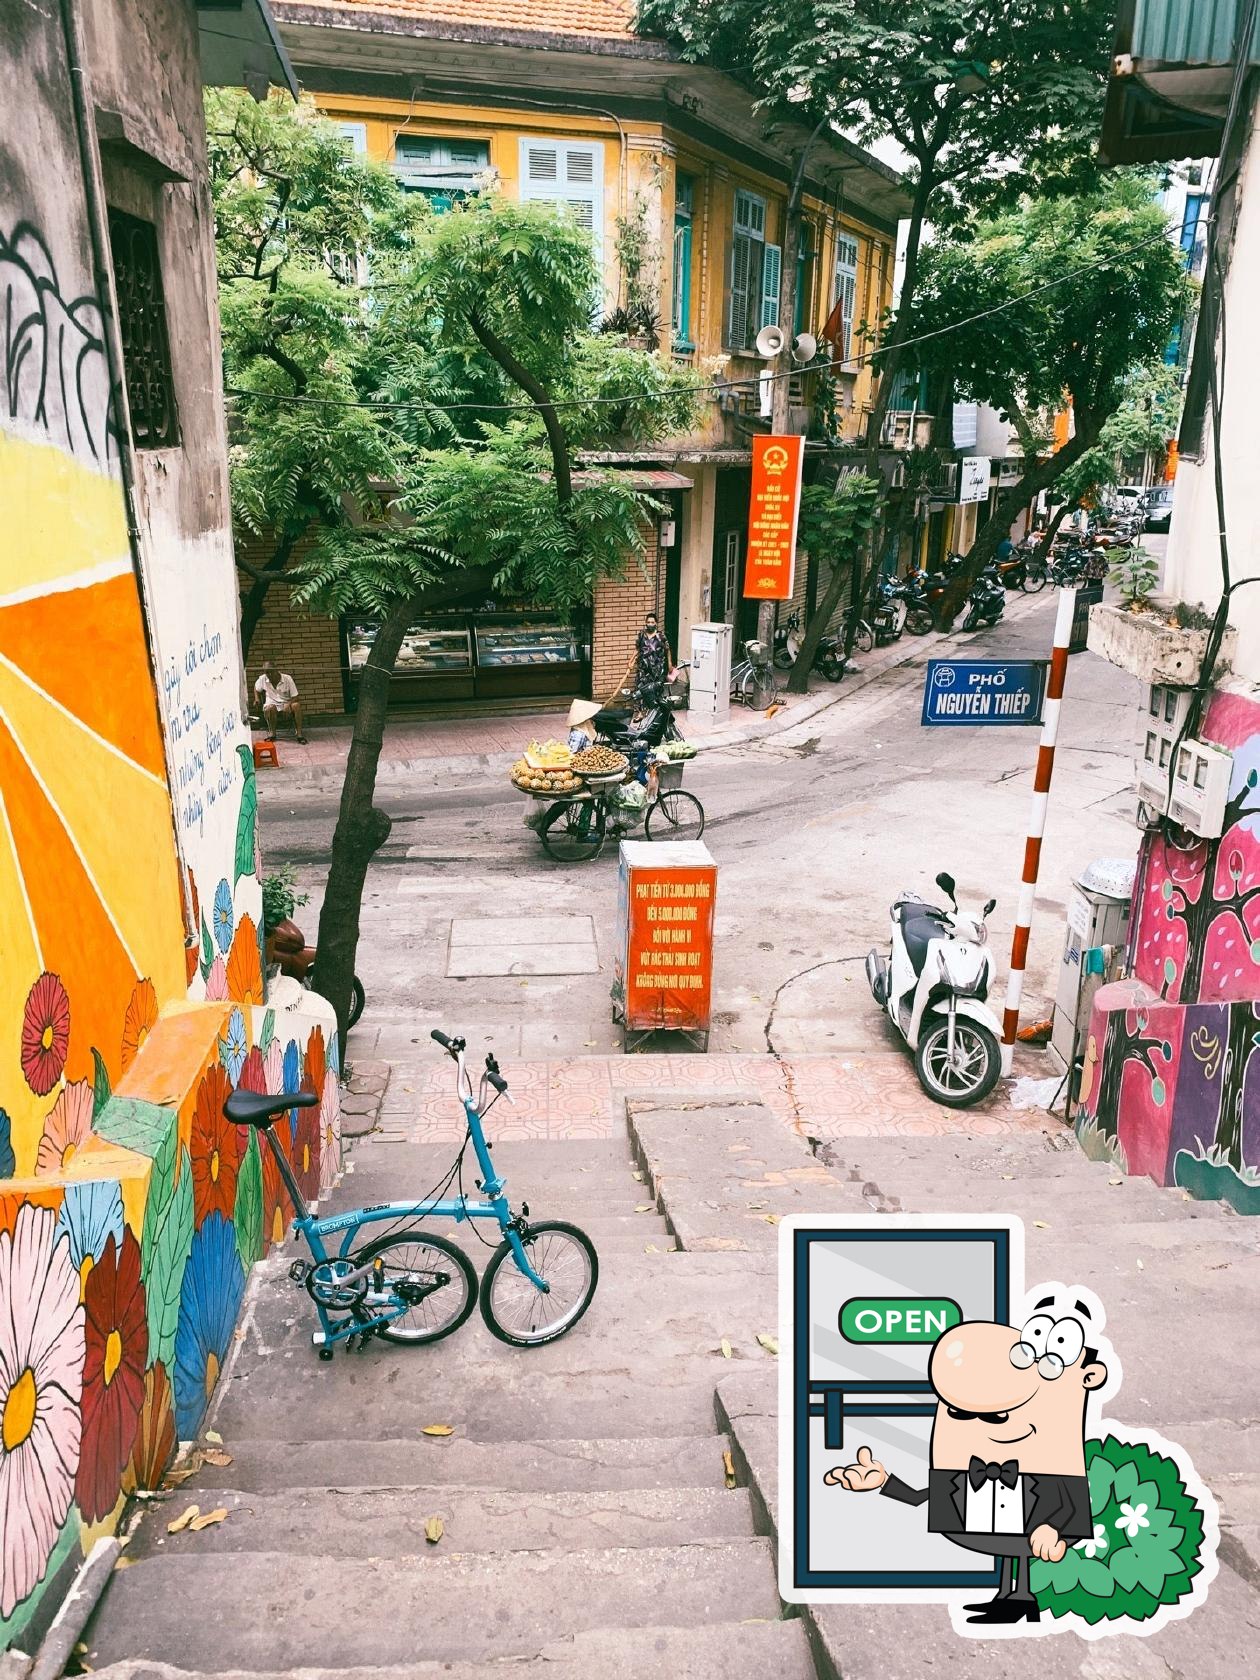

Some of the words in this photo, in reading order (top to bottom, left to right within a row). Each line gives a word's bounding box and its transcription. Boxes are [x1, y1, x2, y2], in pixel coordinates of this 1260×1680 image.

[968, 668, 1008, 686] PHỐ
[935, 686, 991, 715] NGUYỄN
[994, 687, 1031, 715] THIẾP
[320, 1216, 356, 1232] BROMPTON
